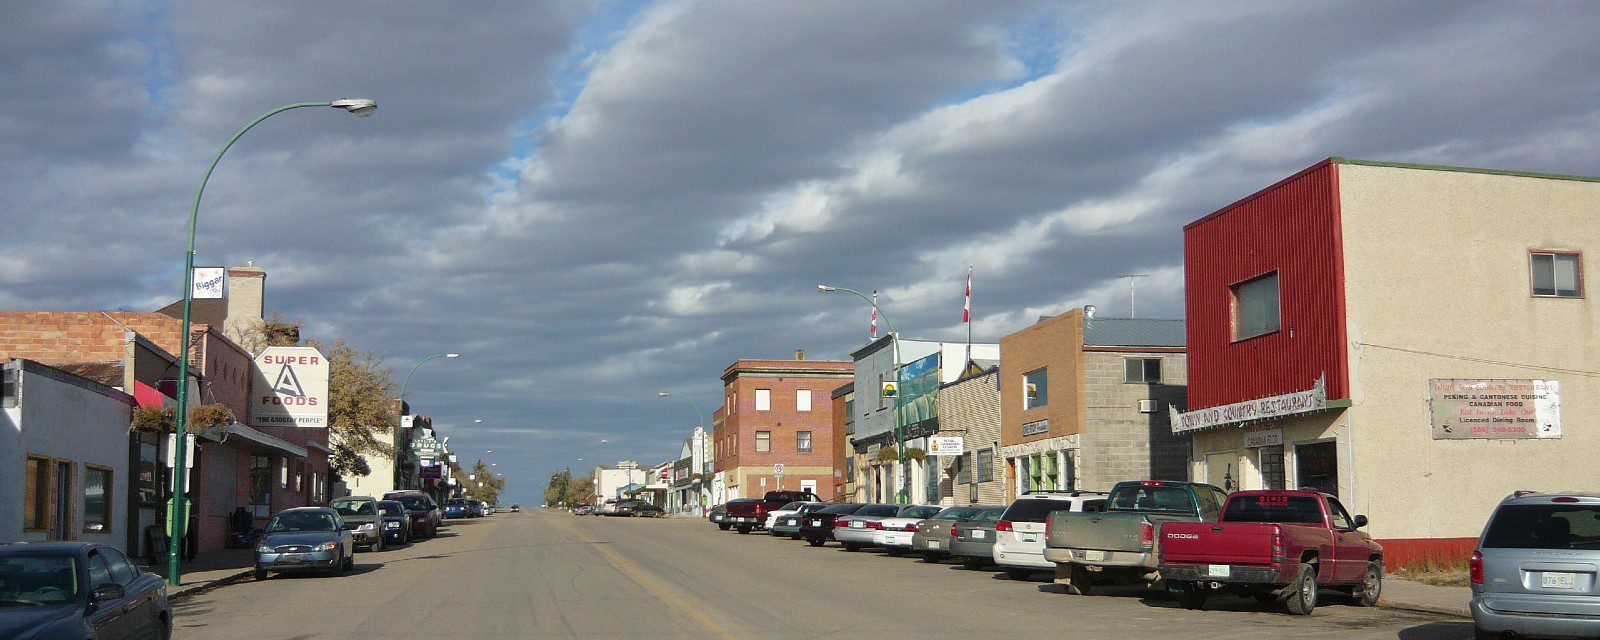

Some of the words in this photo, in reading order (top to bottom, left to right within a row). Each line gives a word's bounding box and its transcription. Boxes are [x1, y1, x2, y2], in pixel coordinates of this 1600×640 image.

[195, 275, 223, 290] Biggar
[264, 355, 319, 365] SUPER
[262, 396, 318, 406] FOODS
[1181, 413, 1201, 428] TOWN
[1203, 409, 1219, 423] AND
[1224, 402, 1257, 420] COUNTRY
[1260, 393, 1314, 415] RESTAURANT
[1492, 417, 1514, 425] Dining
